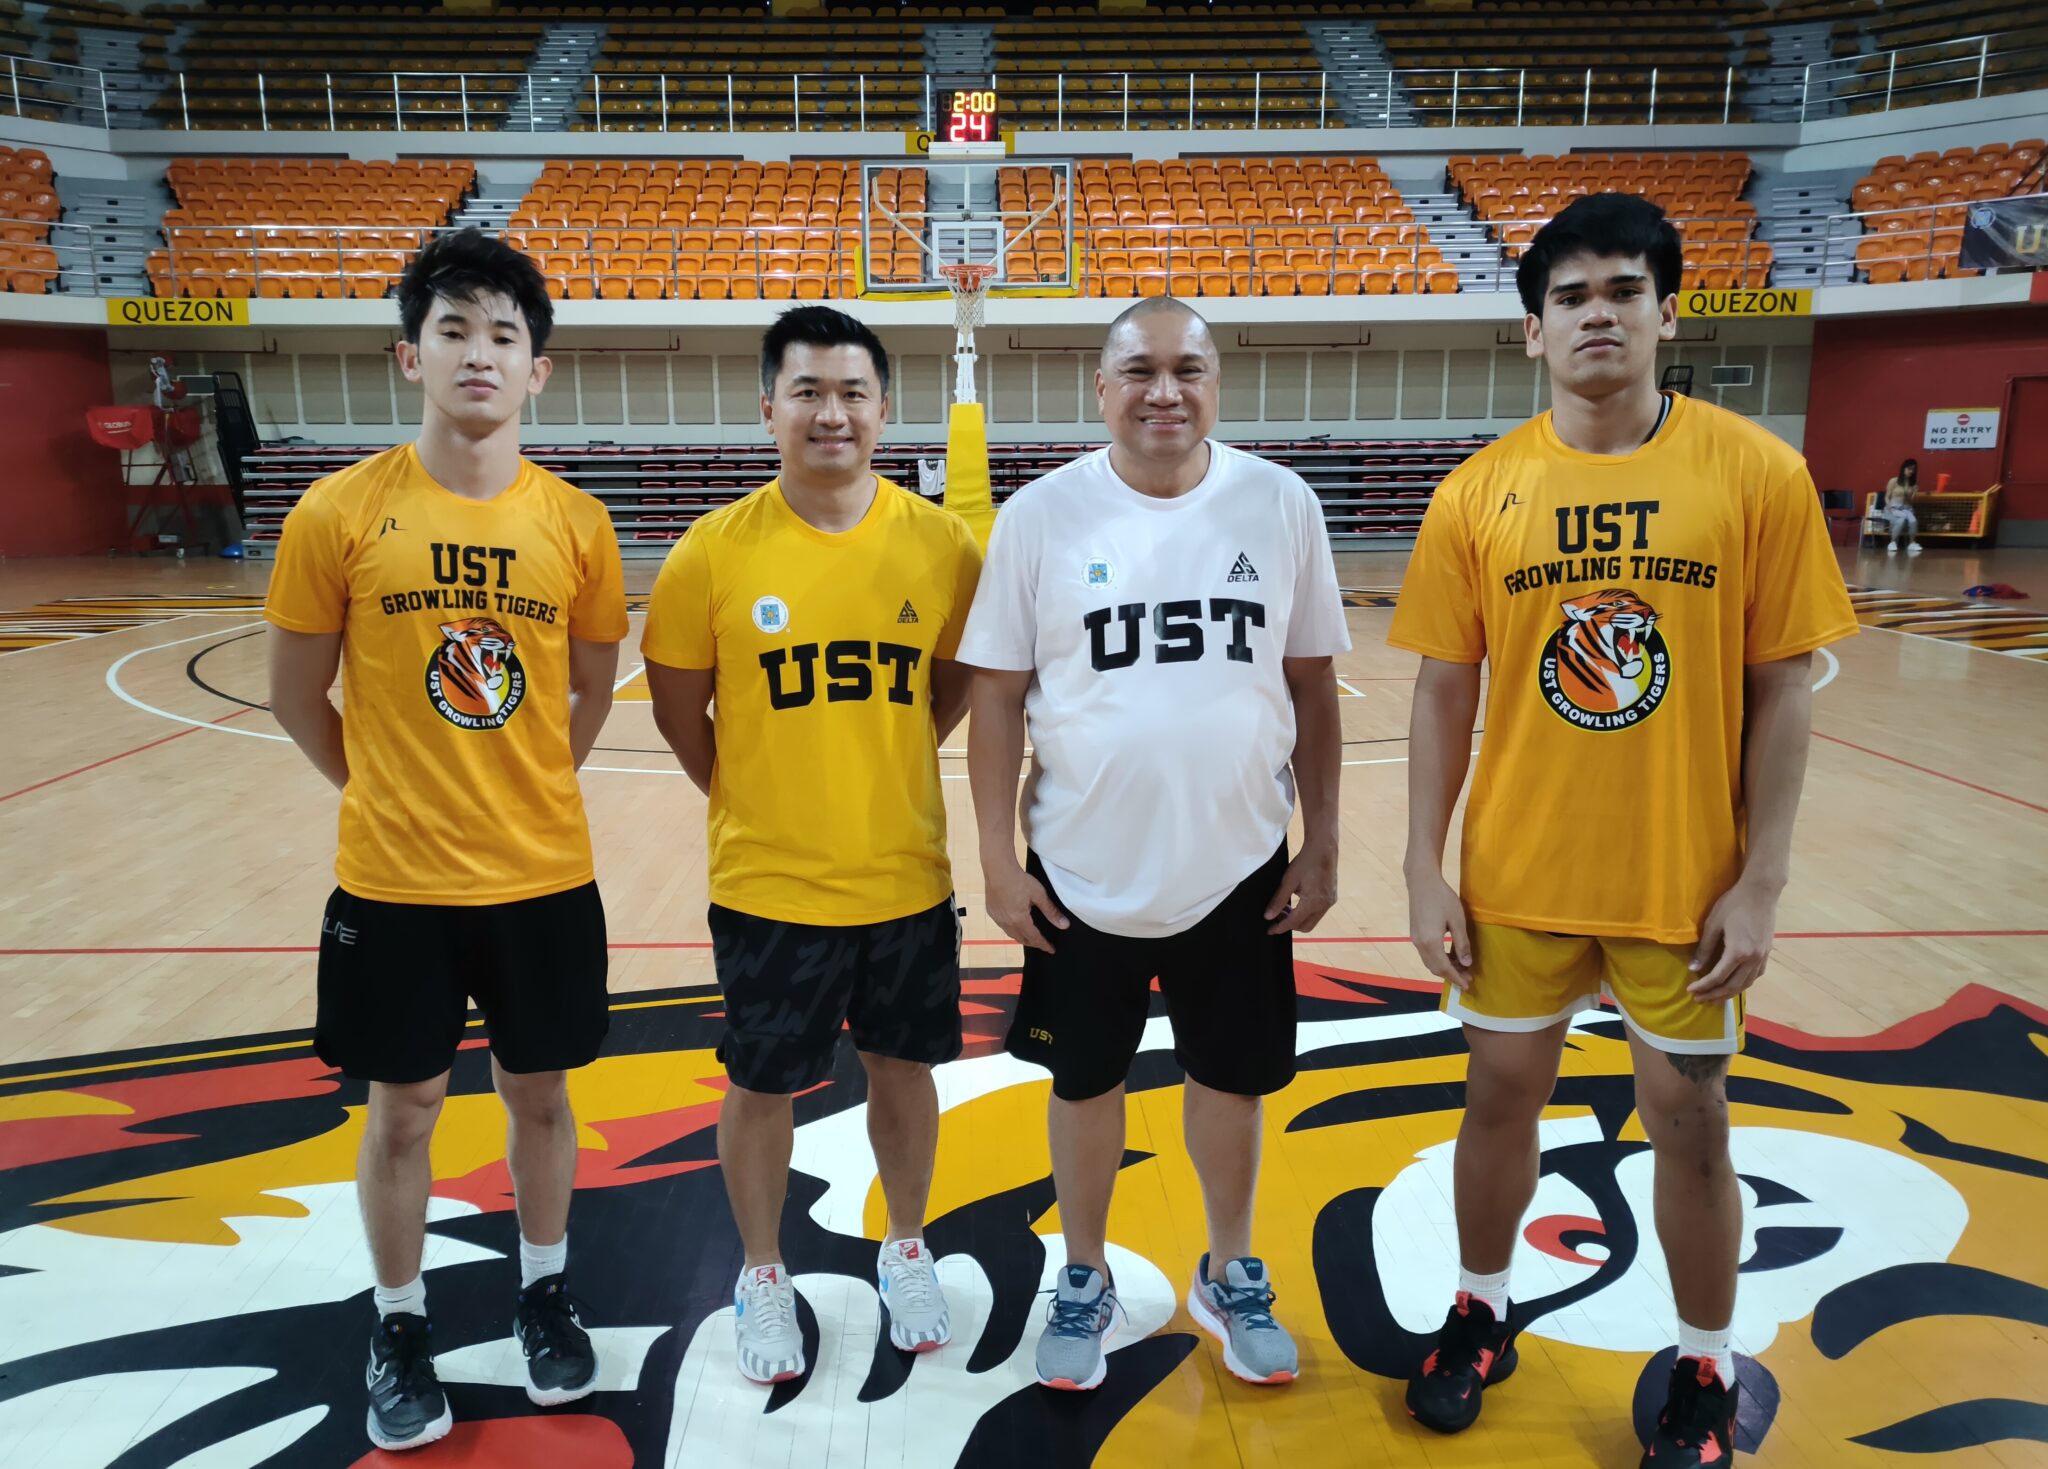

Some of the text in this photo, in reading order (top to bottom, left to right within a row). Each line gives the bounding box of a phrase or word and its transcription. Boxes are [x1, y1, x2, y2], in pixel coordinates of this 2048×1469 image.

[953, 91, 996, 113] 2:00
[950, 113, 986, 142] 24
[2015, 224, 2048, 254] U
[122, 301, 233, 323] QUEZON
[1689, 292, 1797, 316] QUEZON
[1953, 426, 1992, 434] ENTRY
[1555, 500, 1660, 555] UST
[430, 543, 517, 589] UST
[1227, 574, 1260, 583] DELTA
[1504, 555, 1718, 596] GROWLING TIGERS
[380, 589, 559, 625] GROWLING TIGERS
[1083, 598, 1266, 673] UST
[758, 640, 922, 711] UST
[1543, 652, 1666, 728] UST GROWLING TIGERS
[430, 671, 522, 727] UST GROWLING TIGERS
